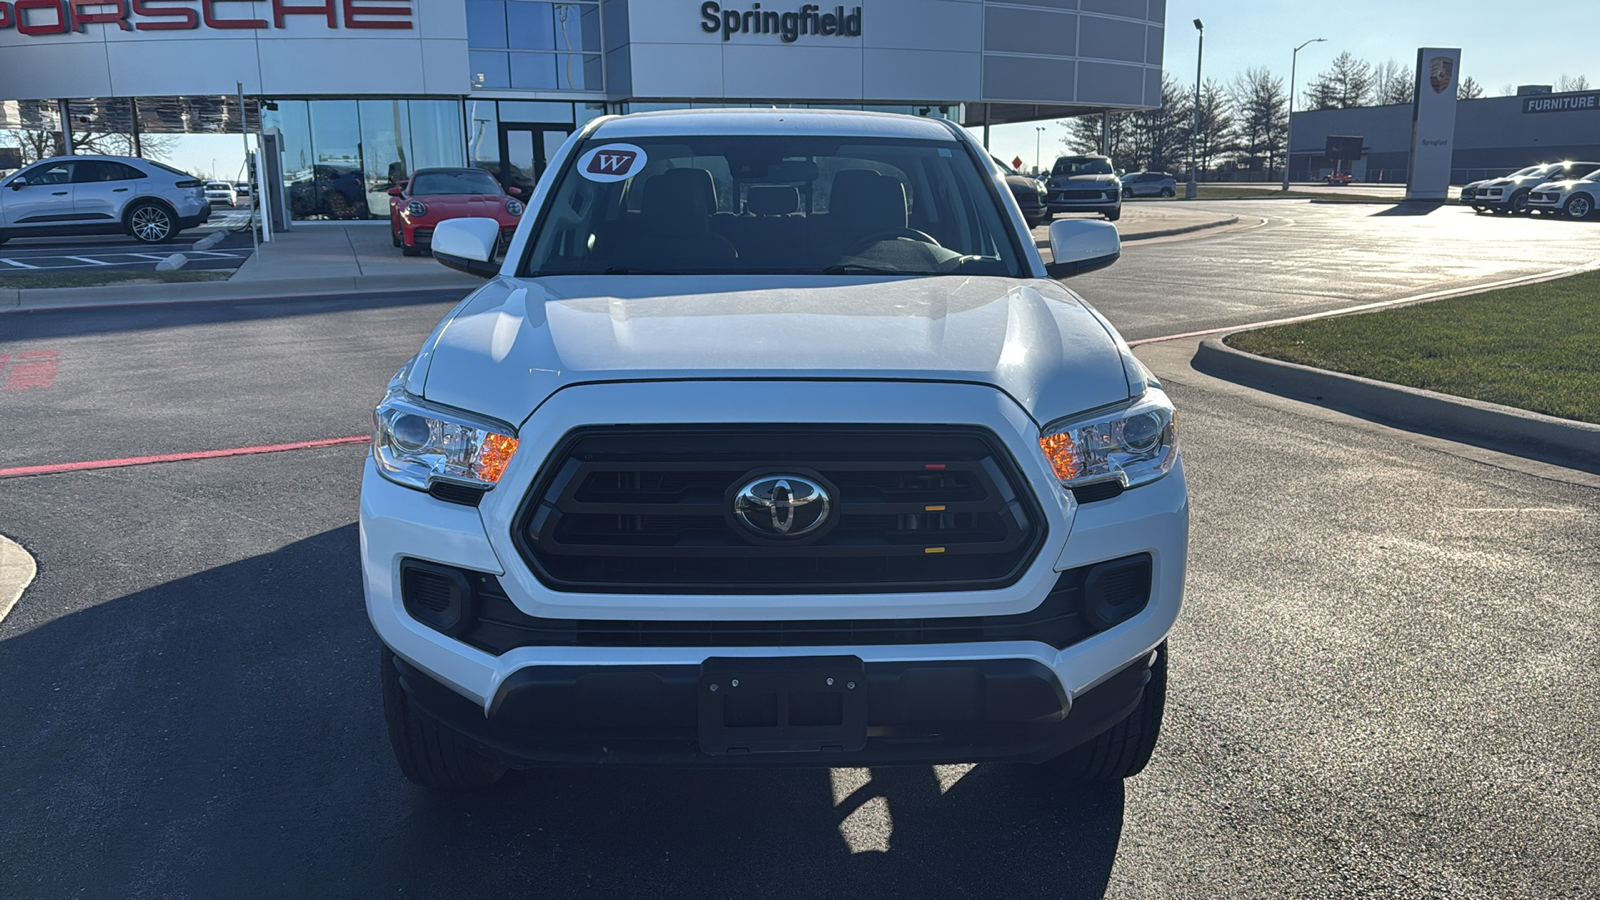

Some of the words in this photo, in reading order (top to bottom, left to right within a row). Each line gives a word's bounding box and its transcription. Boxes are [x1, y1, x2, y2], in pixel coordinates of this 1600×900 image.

[0, 0, 413, 35] ORSCHE
[701, 1, 862, 43] Springfield
[1528, 96, 1595, 111] FURNITURE
[599, 154, 632, 172] W
